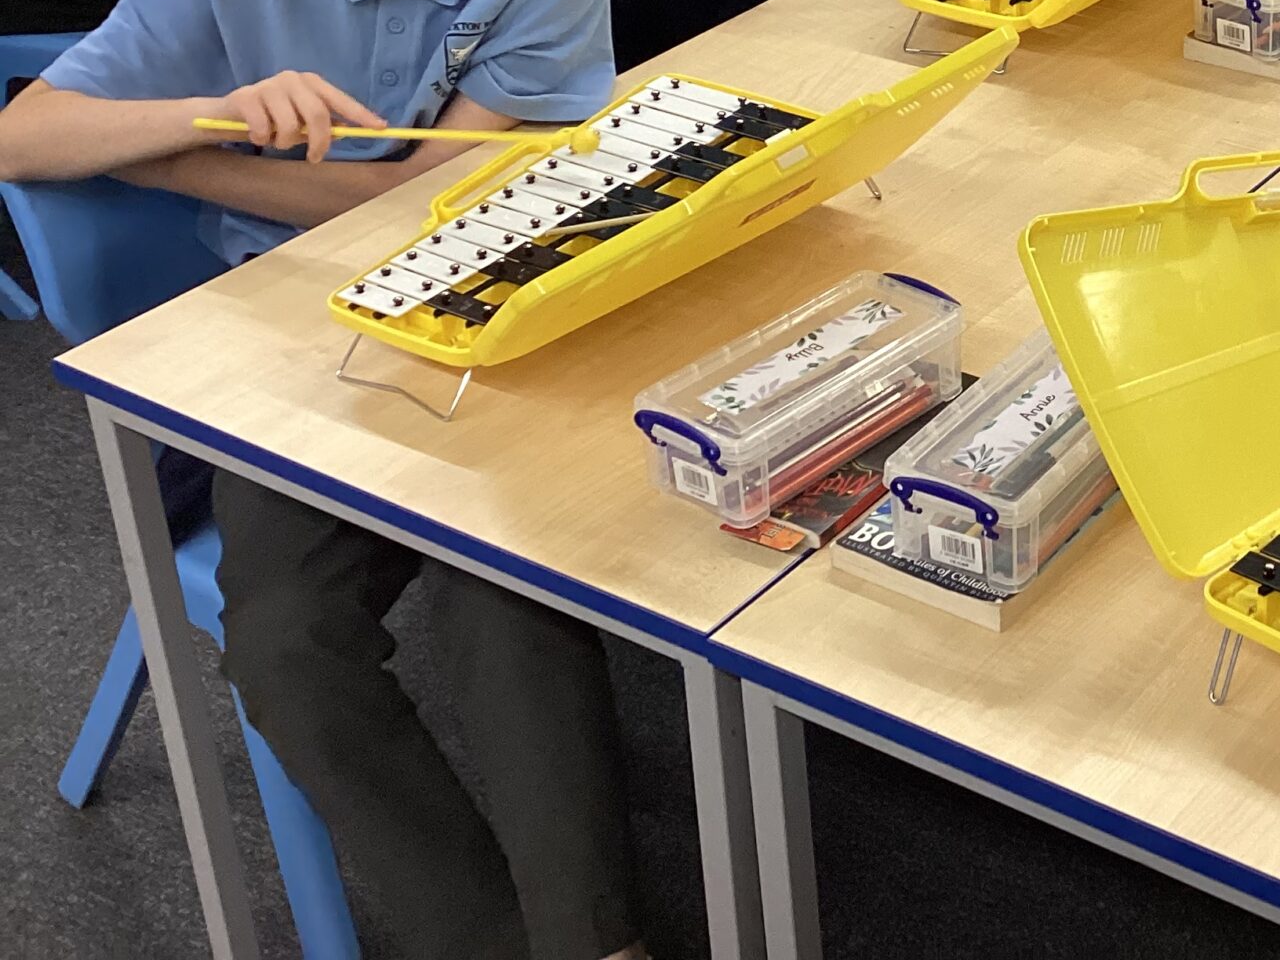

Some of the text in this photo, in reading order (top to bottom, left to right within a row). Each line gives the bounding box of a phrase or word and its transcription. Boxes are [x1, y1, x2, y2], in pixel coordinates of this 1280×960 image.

[785, 342, 824, 362] Billy
[1019, 394, 1056, 422] Annie
[848, 522, 896, 551] BO
[841, 539, 905, 568] ILLUSTRATED
[923, 571, 970, 592] QUENTIN
[937, 566, 951, 577] of
[951, 571, 1008, 598] Childhood
